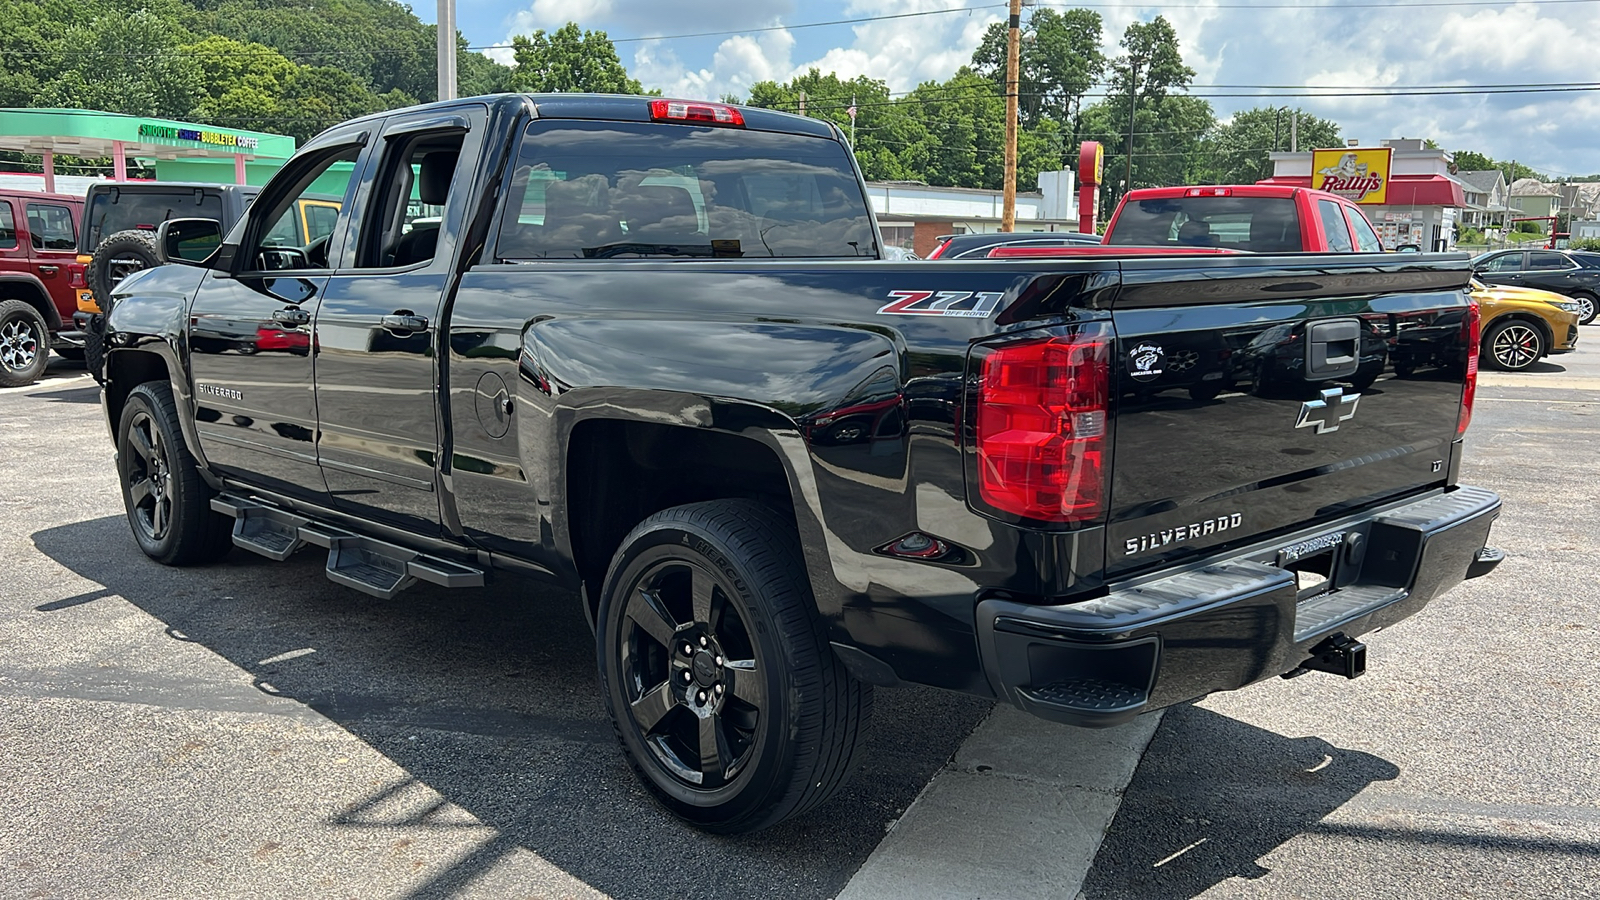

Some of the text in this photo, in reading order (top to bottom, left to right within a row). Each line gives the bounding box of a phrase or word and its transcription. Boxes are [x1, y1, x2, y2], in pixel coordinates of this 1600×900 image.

[201, 131, 237, 146] BUBBLETEA
[237, 135, 259, 149] COFFEE
[1319, 171, 1382, 199] Rally's
[876, 290, 1005, 318] Z71
[199, 383, 243, 401] SILVERADO
[1123, 512, 1243, 556] SILVERADO
[695, 540, 766, 635] HERCULES
